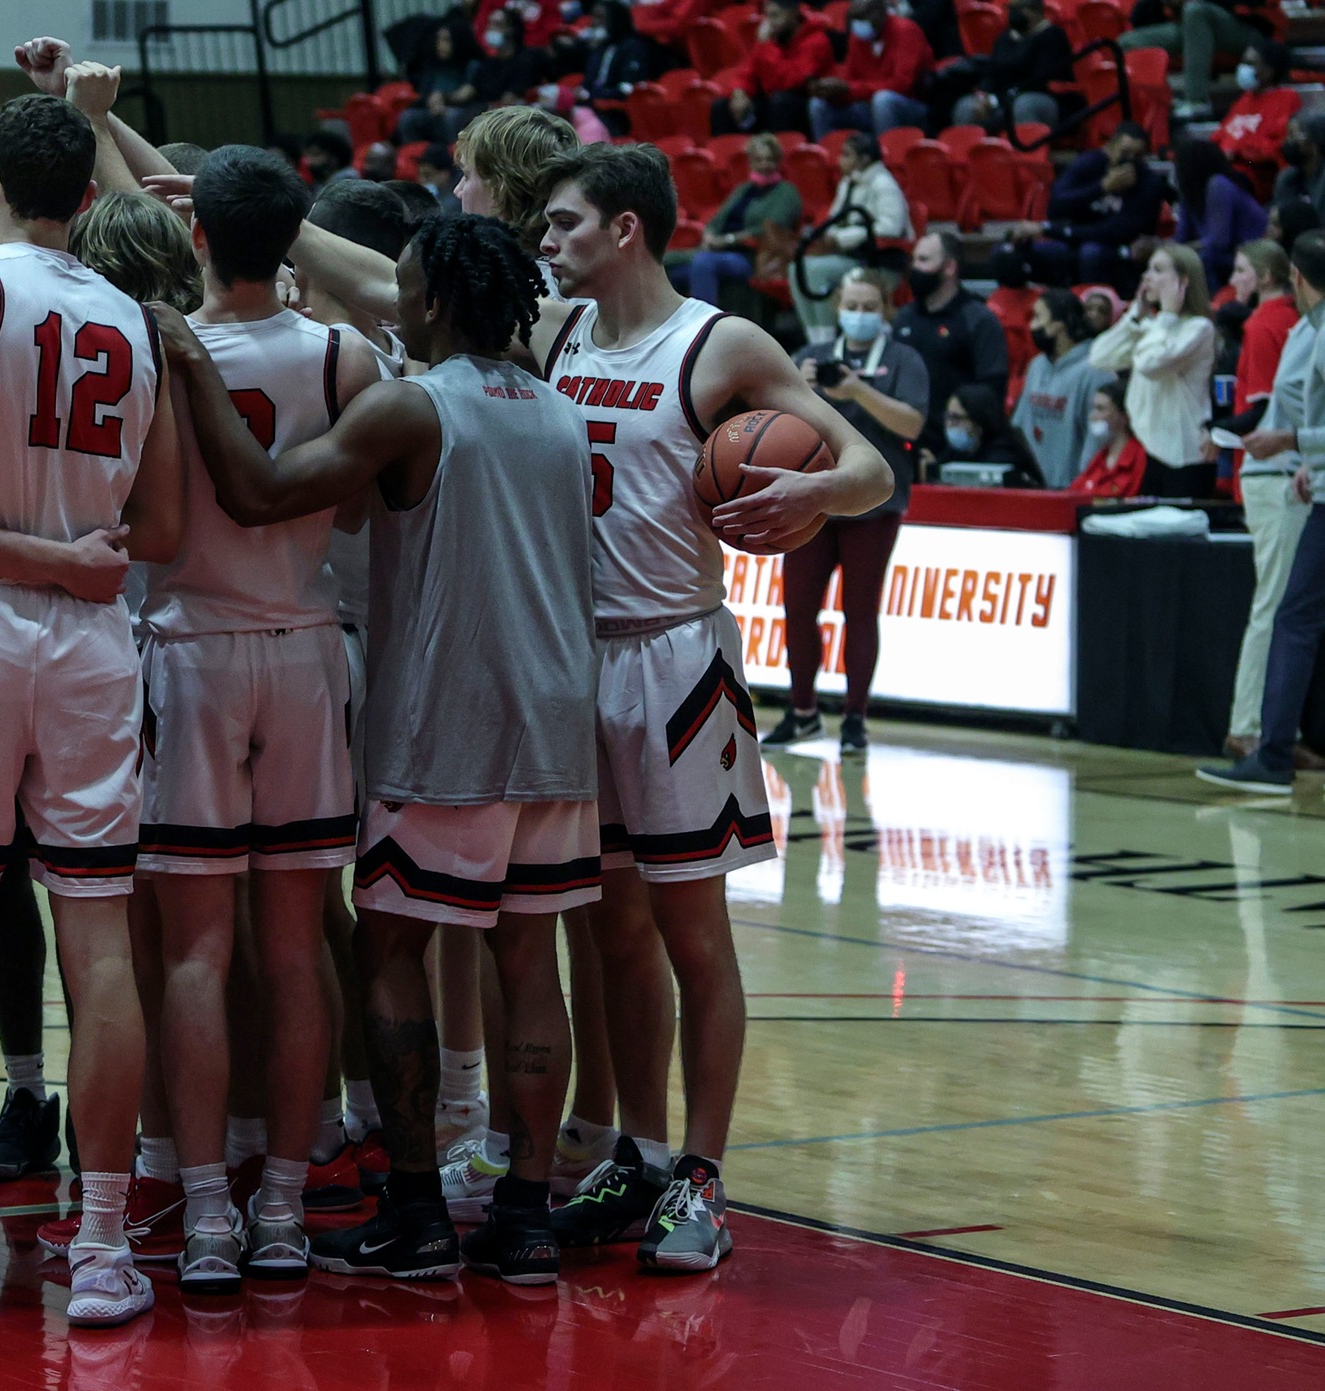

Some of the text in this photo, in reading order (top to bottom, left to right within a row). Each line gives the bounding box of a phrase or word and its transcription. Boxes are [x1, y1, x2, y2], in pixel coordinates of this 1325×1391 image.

[28, 310, 133, 459] 12
[556, 375, 665, 412] CATHOLIC
[885, 564, 1057, 629] NIVERSITY
